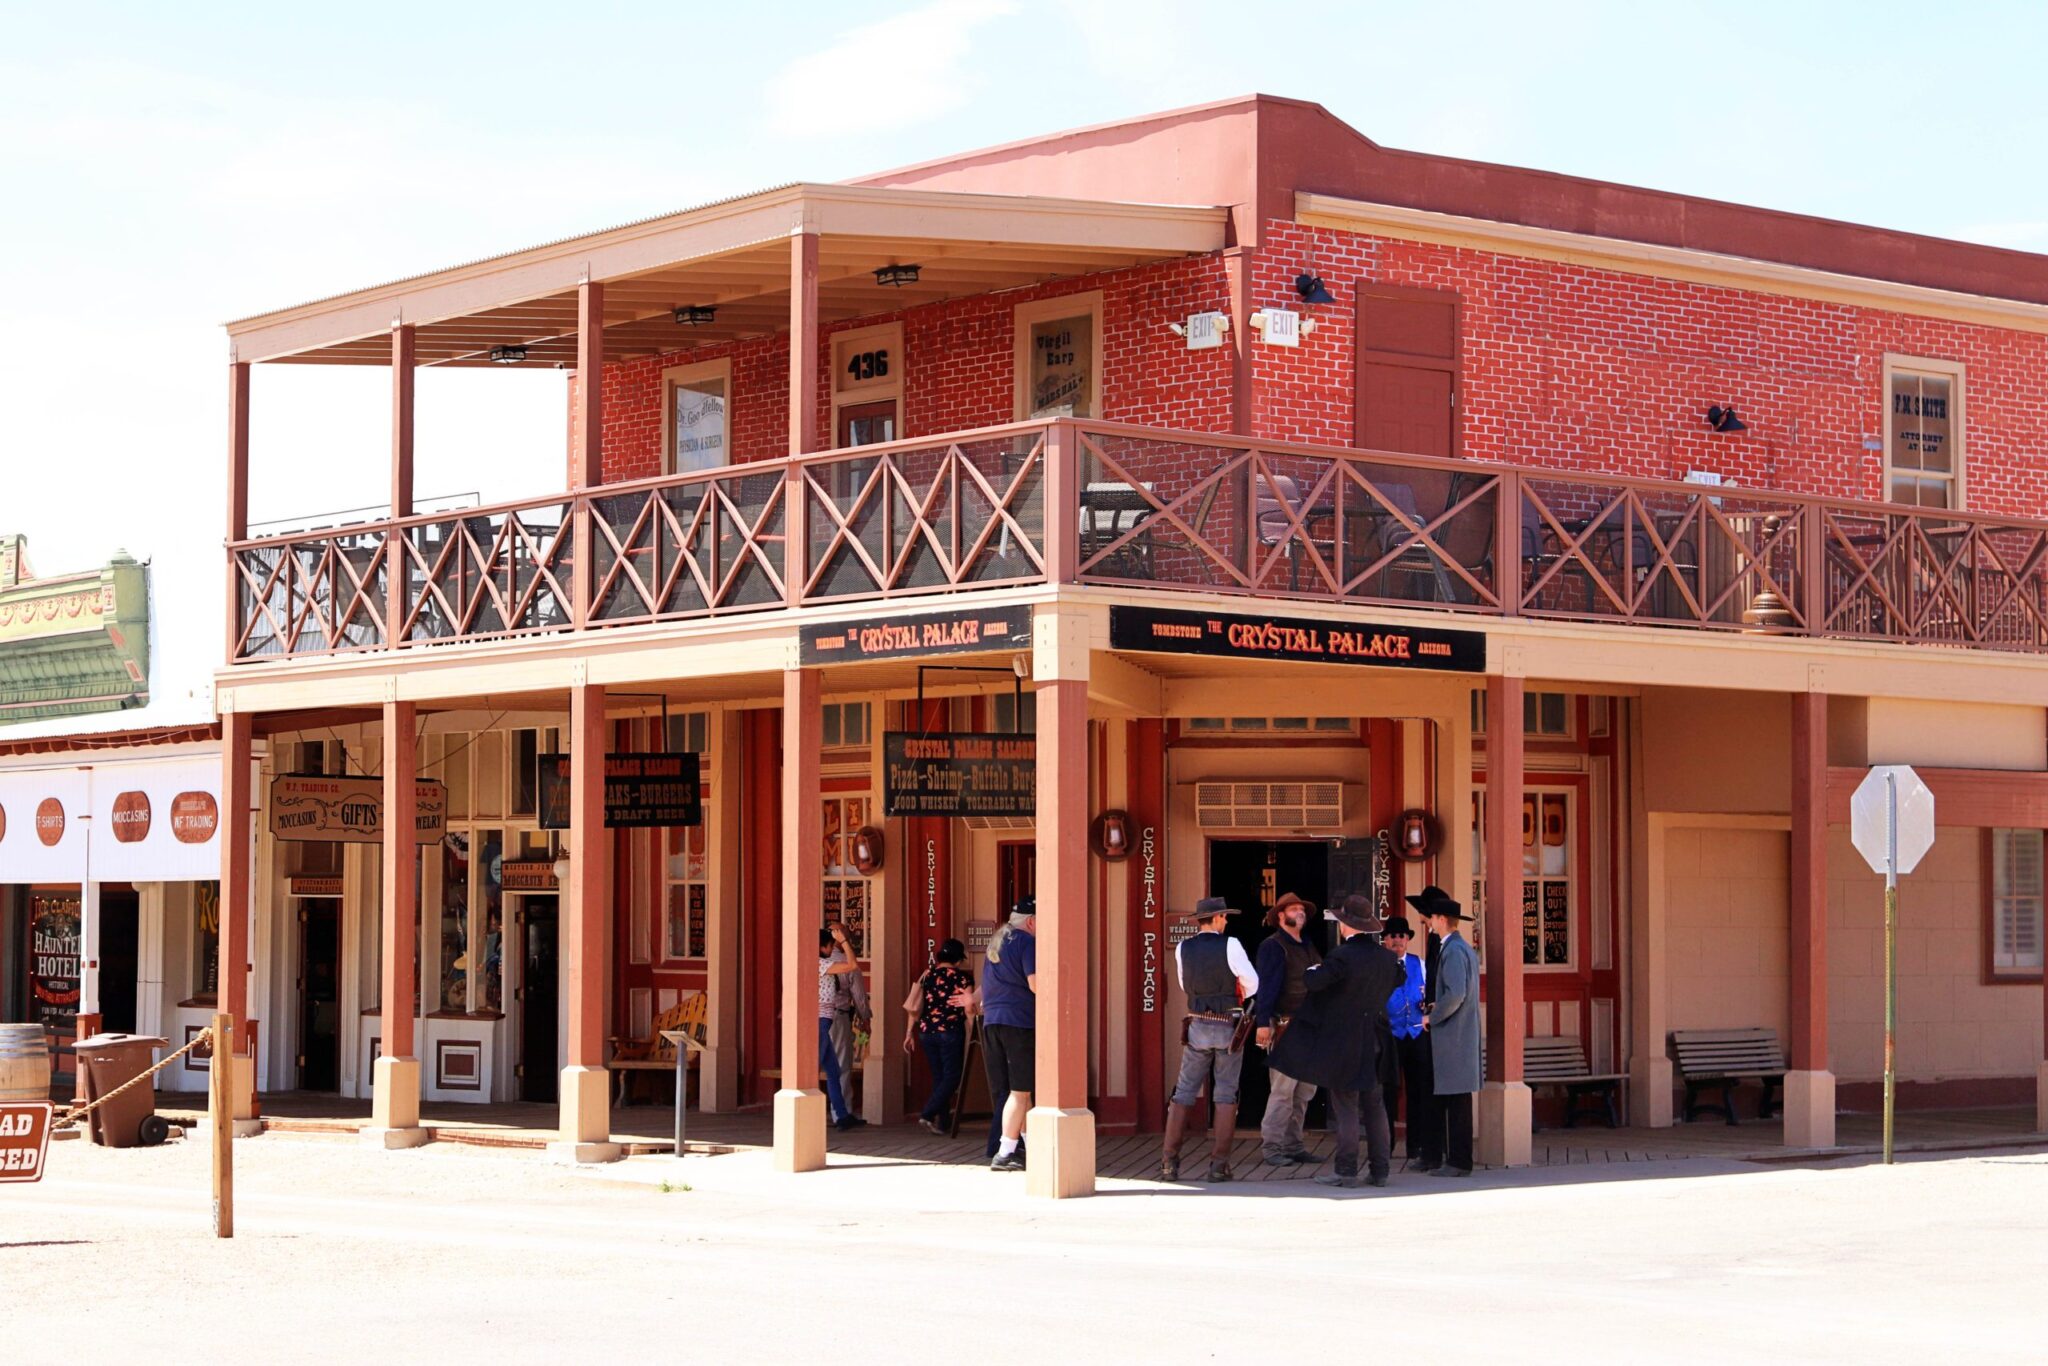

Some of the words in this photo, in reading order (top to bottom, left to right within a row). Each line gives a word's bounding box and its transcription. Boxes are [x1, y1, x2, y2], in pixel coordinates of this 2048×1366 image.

[1193, 316, 1213, 339] EXIT
[1273, 312, 1294, 336] EXIT
[1036, 331, 1070, 349] Virgil
[848, 350, 888, 381] 436
[1046, 352, 1074, 366] Earp
[1914, 396, 1946, 419] SMITH
[1900, 431, 1943, 443] ATTORNEY
[1907, 442, 1918, 451] AT
[1922, 444, 1938, 453] LAW
[860, 623, 921, 653] CRYSTAL
[923, 619, 980, 648] PALACE
[1152, 623, 1201, 639] TOMBSTONE
[1207, 620, 1223, 634] THE
[1228, 622, 1324, 653] CRYSTAL
[1328, 630, 1411, 659] PALACE
[1418, 642, 1452, 656] ARIZONA
[904, 739, 950, 759] CRYSTAL
[954, 739, 993, 759] PALACE
[301, 783, 328, 793] TRADING
[1012, 765, 1036, 797] Burg
[920, 795, 960, 810] WHISKEY
[966, 796, 1015, 811] TOLERABLE
[1019, 797, 1036, 810] WAT
[35, 815, 63, 828] T-SHIRTS
[112, 808, 149, 824] MOCCASINS
[185, 816, 213, 829] TRADING
[278, 810, 317, 830] MOCCASINS
[341, 803, 377, 826] GIFTS
[416, 814, 442, 831] WELRY
[614, 809, 652, 820] DRAFT
[656, 808, 686, 820] BEER
[927, 840, 936, 927] CRYSTAL
[1143, 827, 1155, 919] CRYSTAL
[1377, 829, 1390, 921] CRYSTAL
[1169, 926, 1198, 934] WEAPONS
[37, 956, 81, 978] HOTEL
[1143, 932, 1156, 1012] PALACE
[0, 1113, 33, 1136] AD
